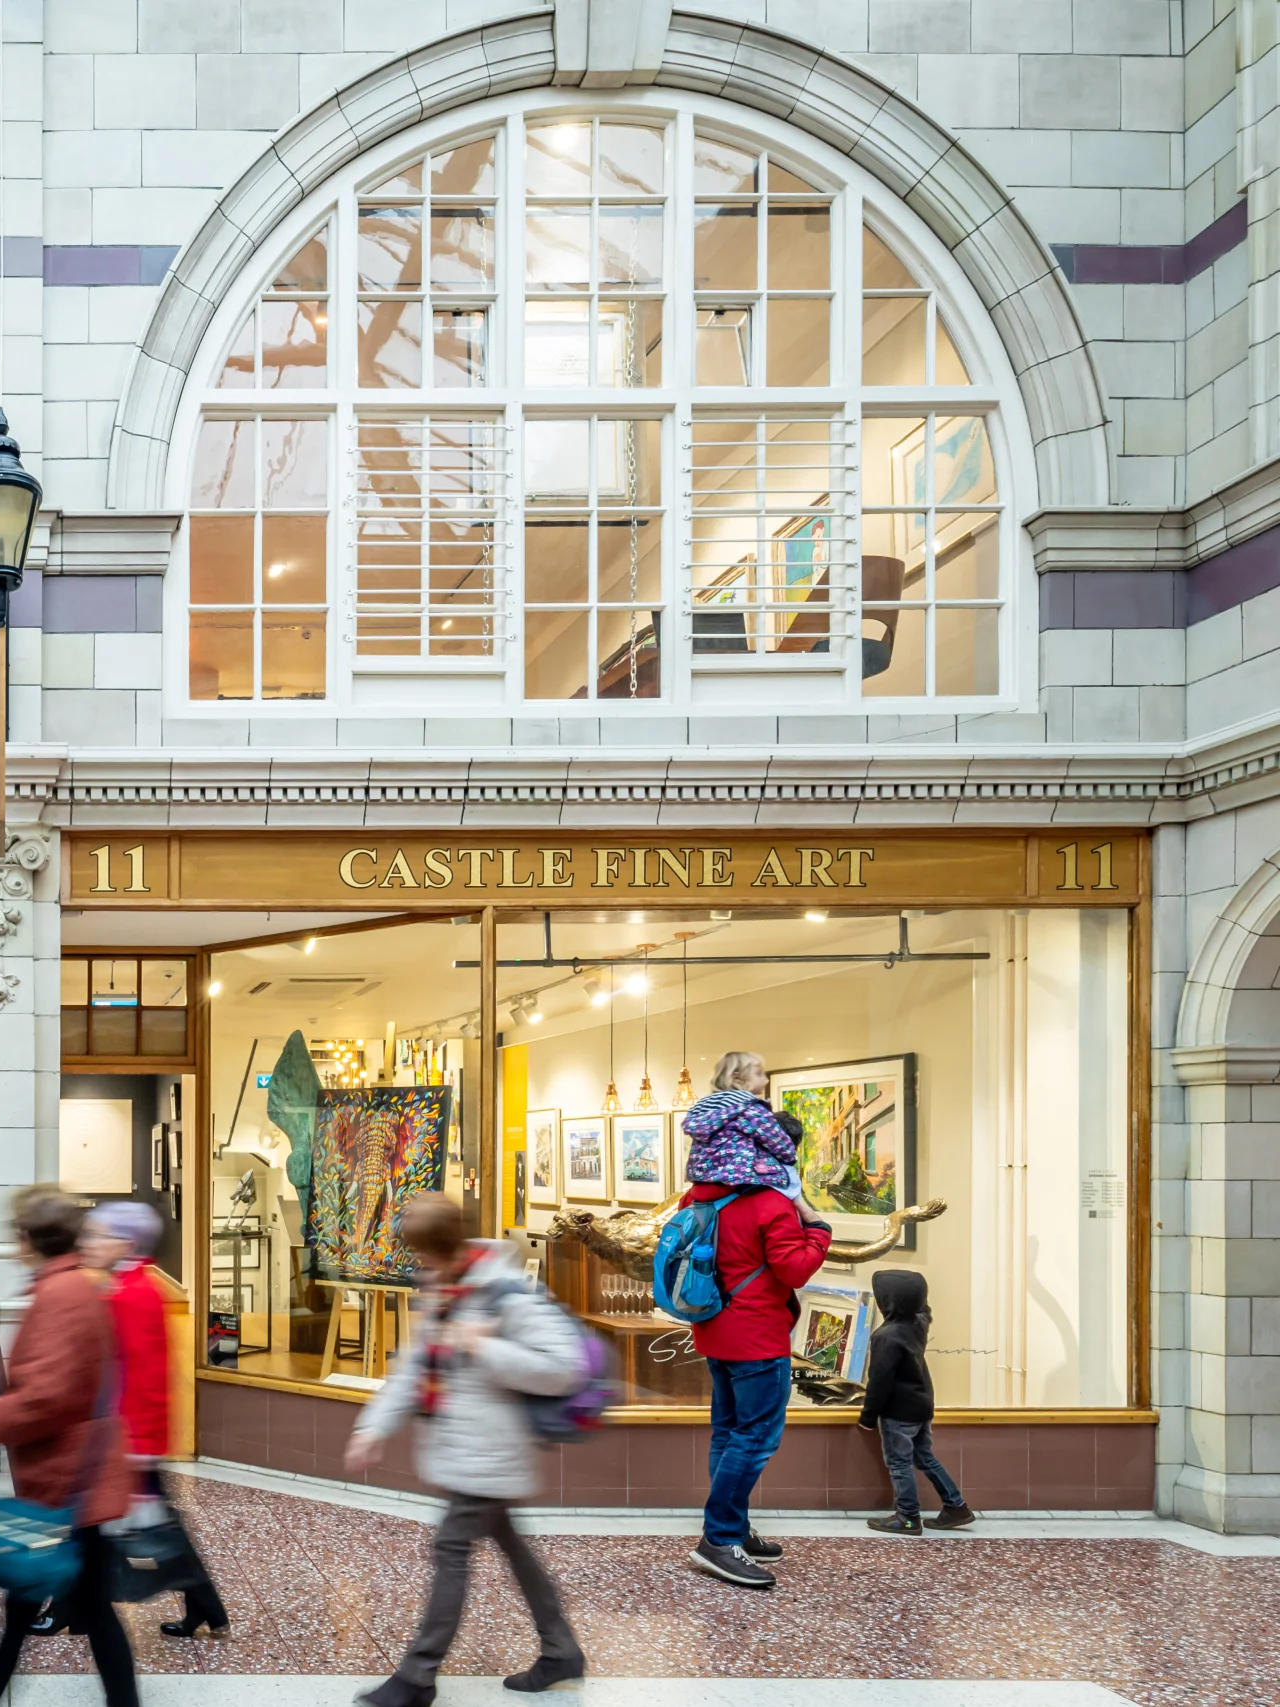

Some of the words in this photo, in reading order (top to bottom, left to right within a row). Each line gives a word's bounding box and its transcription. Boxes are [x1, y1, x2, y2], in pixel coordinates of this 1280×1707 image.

[89, 844, 151, 892] 11
[338, 848, 575, 889] CASTLE
[590, 847, 734, 888] FINE
[750, 847, 875, 888] ART
[1056, 841, 1119, 891] 11
